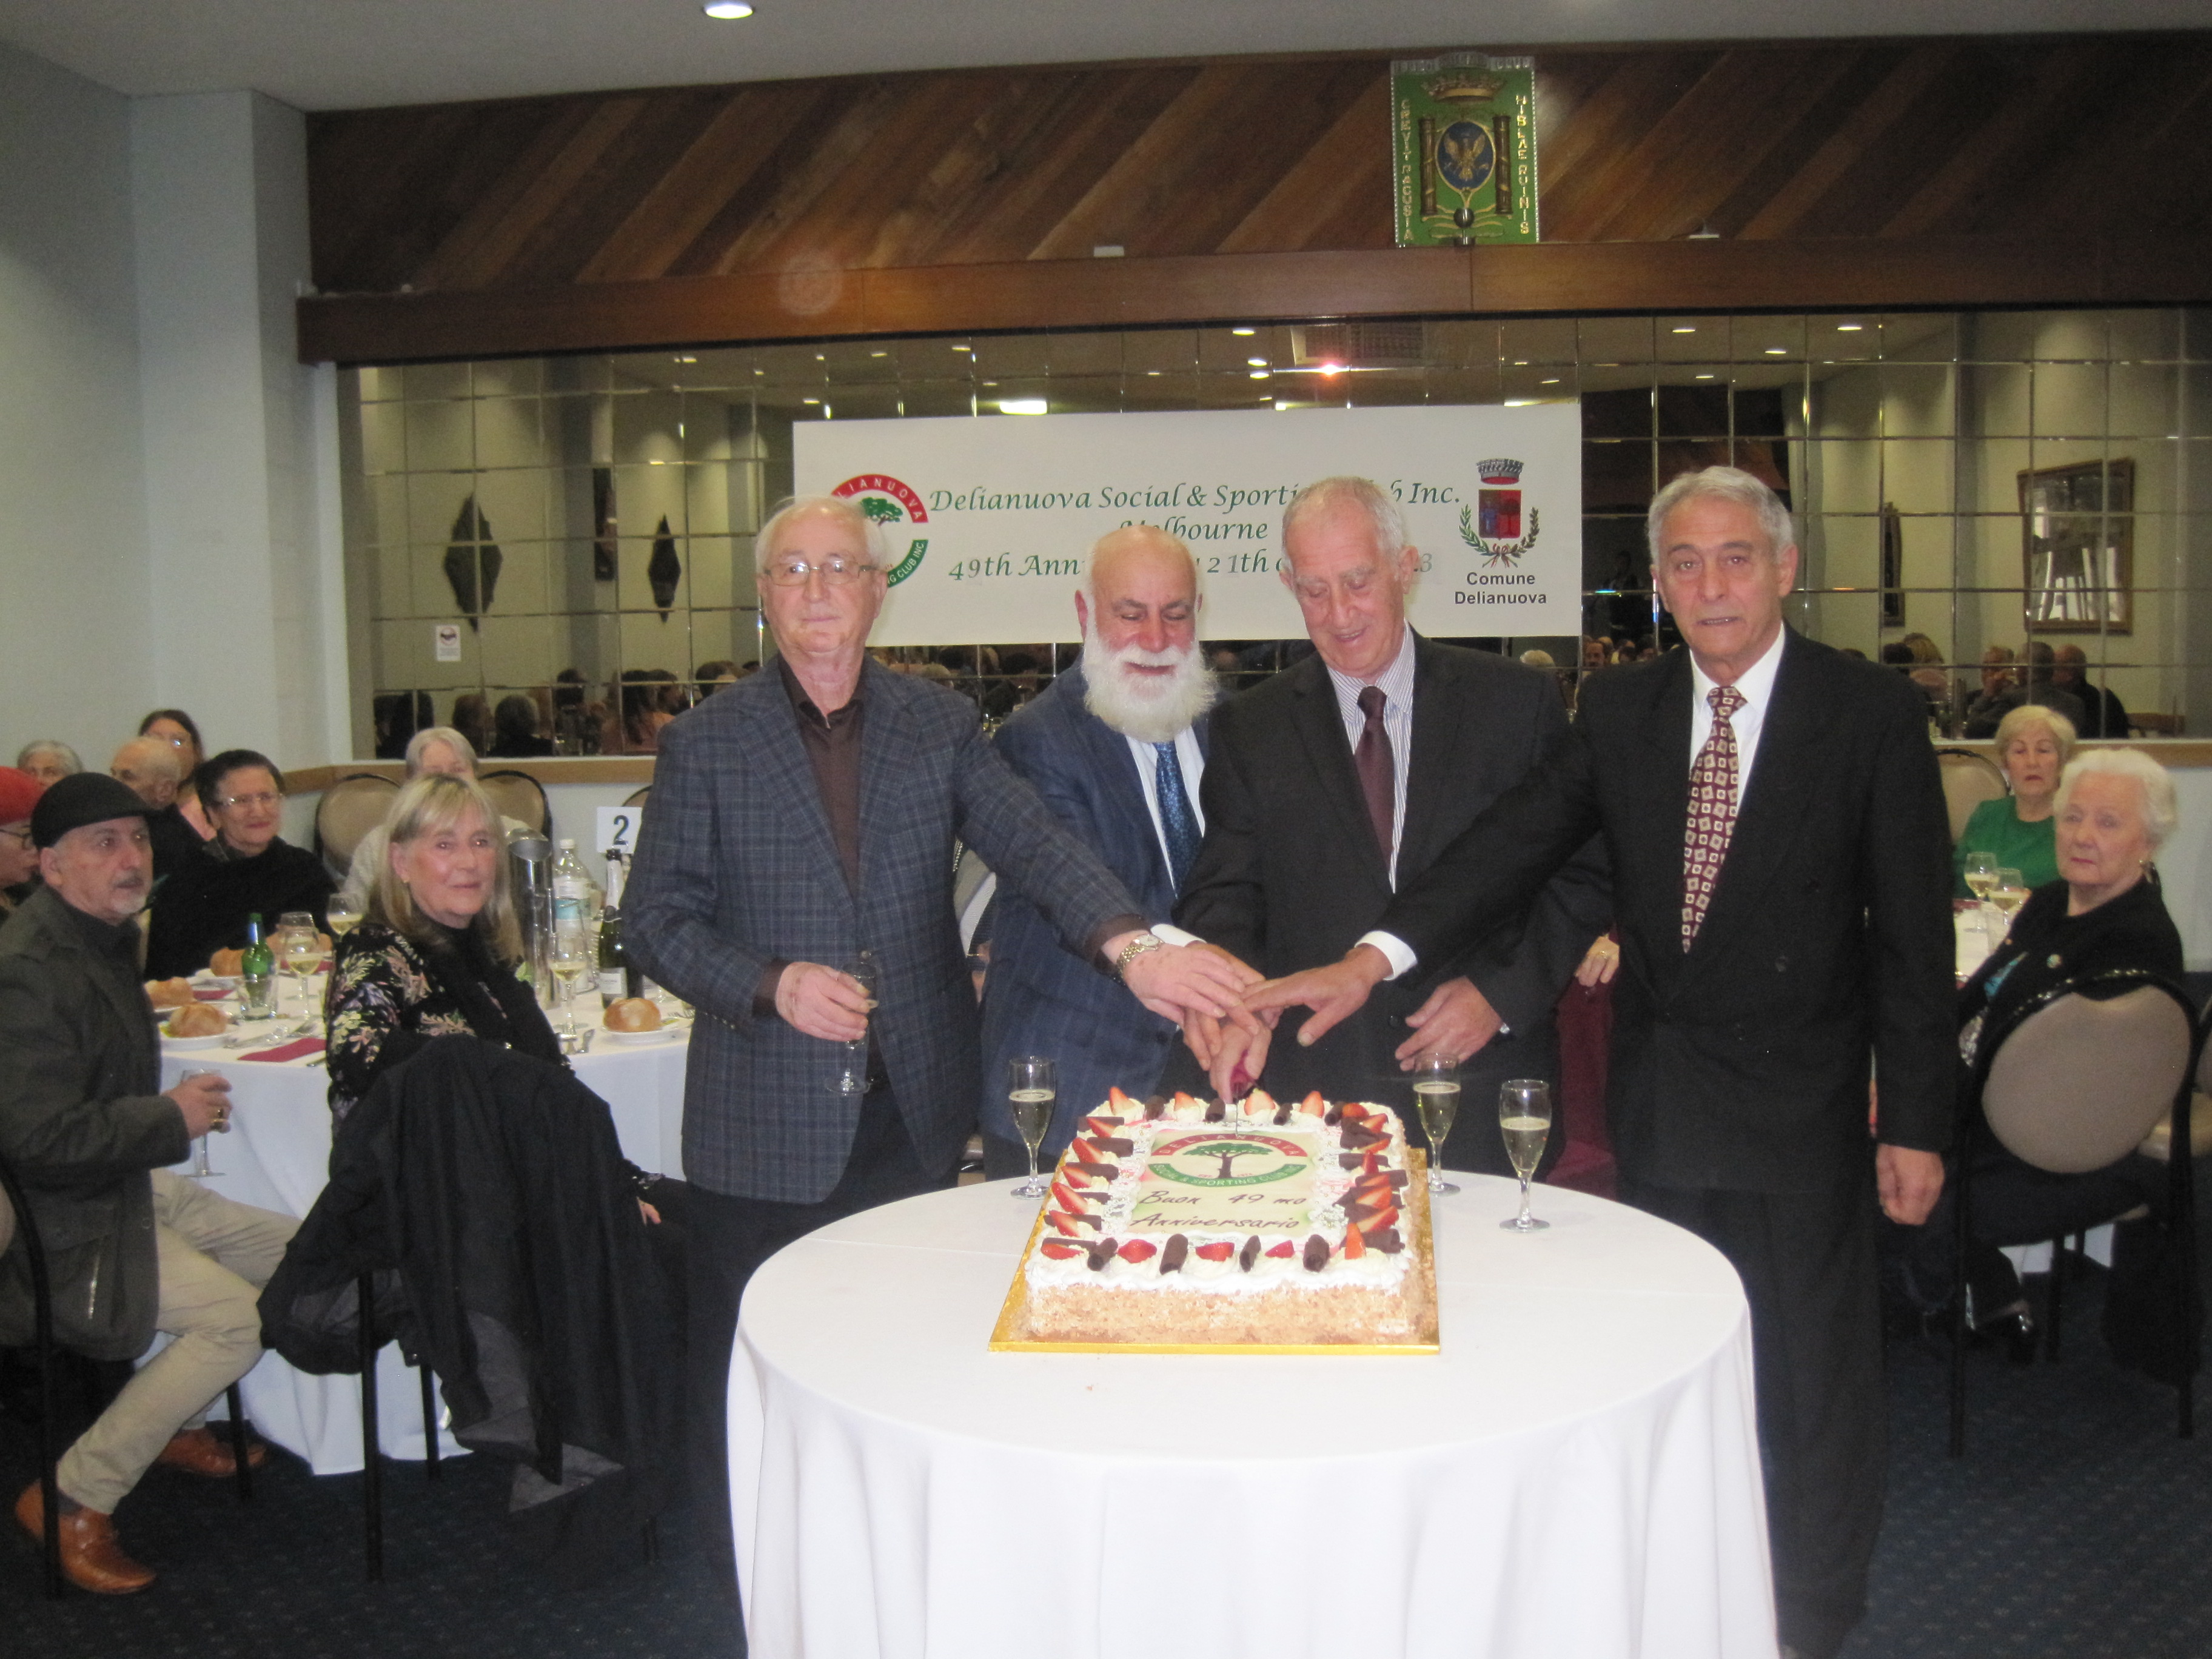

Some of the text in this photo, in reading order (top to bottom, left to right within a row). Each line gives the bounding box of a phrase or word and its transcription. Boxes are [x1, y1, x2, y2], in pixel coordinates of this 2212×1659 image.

[1516, 95, 1529, 234] HIBLAE RUINIS
[930, 486, 1092, 511] Delianuova
[1098, 483, 1186, 508] Social
[1187, 485, 1208, 507] &
[1213, 483, 1299, 514] Sporti
[1407, 483, 1460, 504] Inc.
[897, 558, 916, 578] CLUB
[948, 552, 1012, 580] 49th
[1467, 572, 1535, 585] Comune
[1455, 591, 1547, 605] Delianuova
[613, 815, 629, 845] 2
[1139, 1190, 1201, 1205] Buon
[1228, 1193, 1264, 1204] 49
[1130, 1213, 1299, 1228] Anniversario
